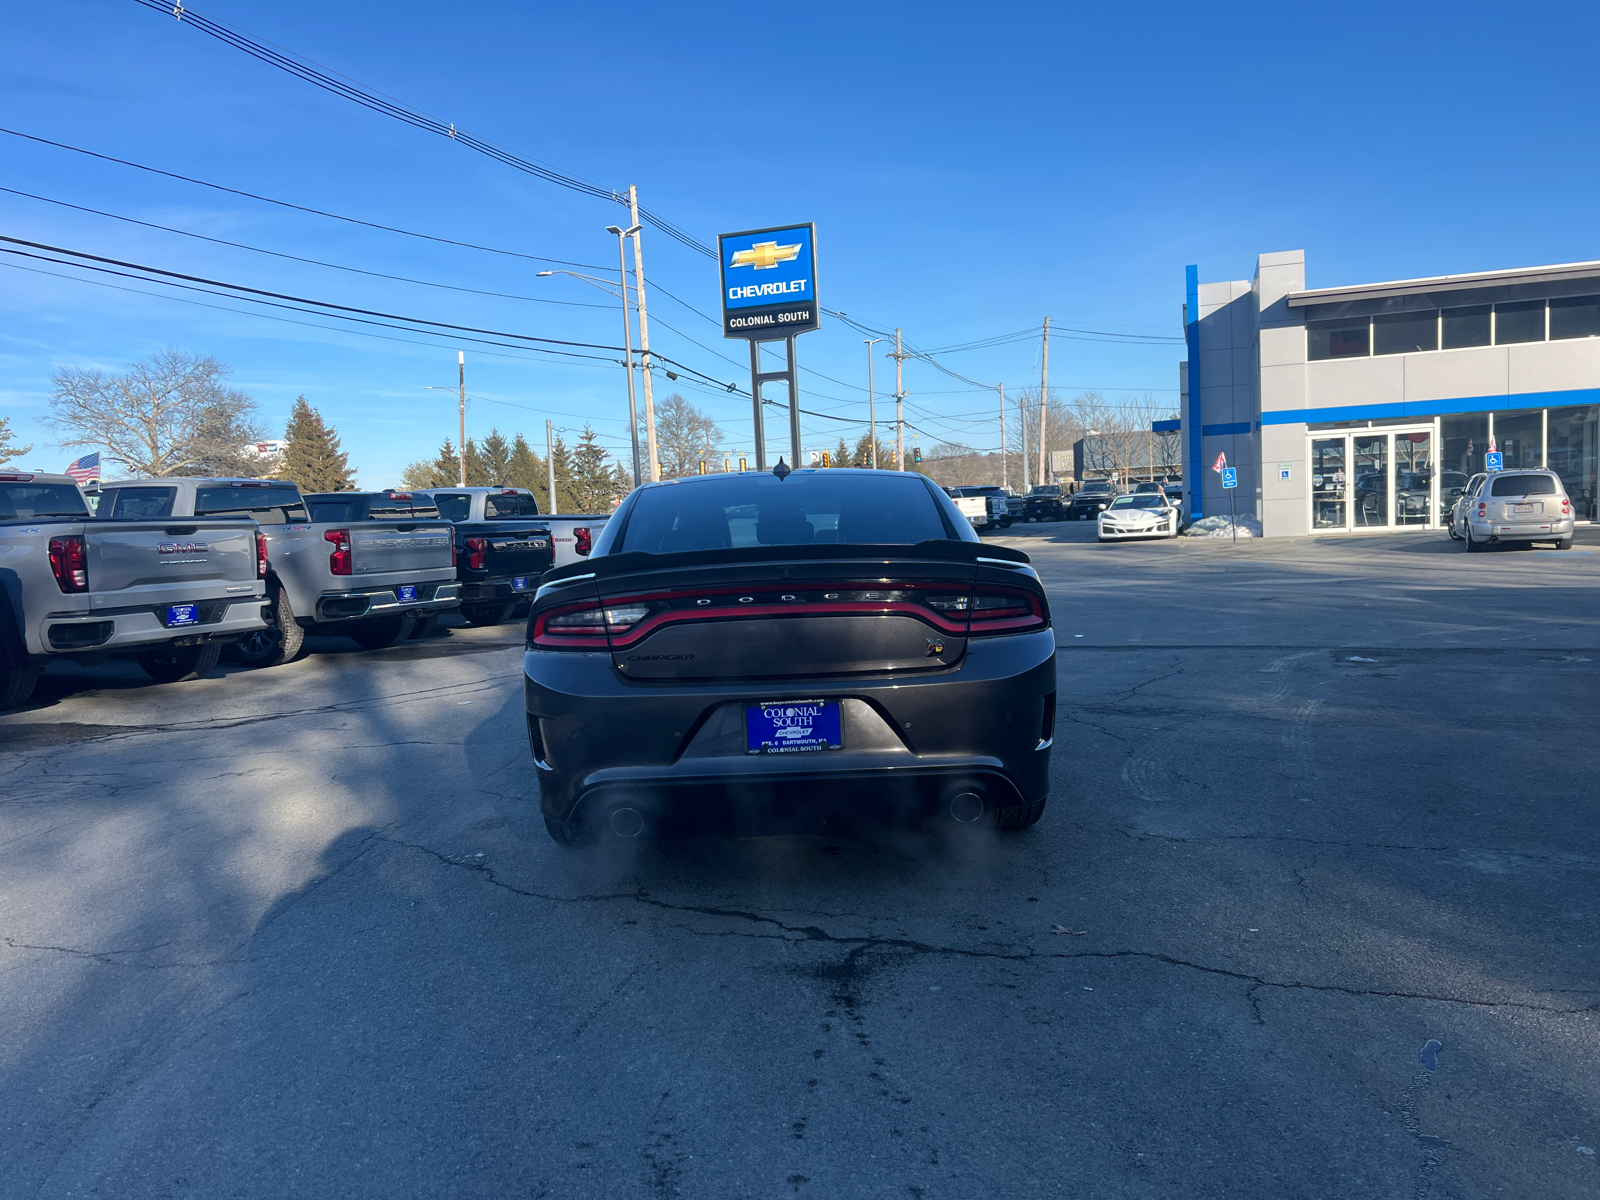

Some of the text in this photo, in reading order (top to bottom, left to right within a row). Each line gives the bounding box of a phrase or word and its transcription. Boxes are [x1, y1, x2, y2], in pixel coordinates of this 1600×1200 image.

[728, 279, 807, 300] CHEVROLET
[730, 310, 810, 328] COLONIAL SOUTH
[157, 541, 209, 555] GMC
[358, 537, 449, 550] CHEVROLET
[696, 591, 880, 606] DODGE
[627, 653, 695, 661] CHARGER
[764, 707, 821, 718] COLONIAL
[773, 717, 813, 727] SOUTH
